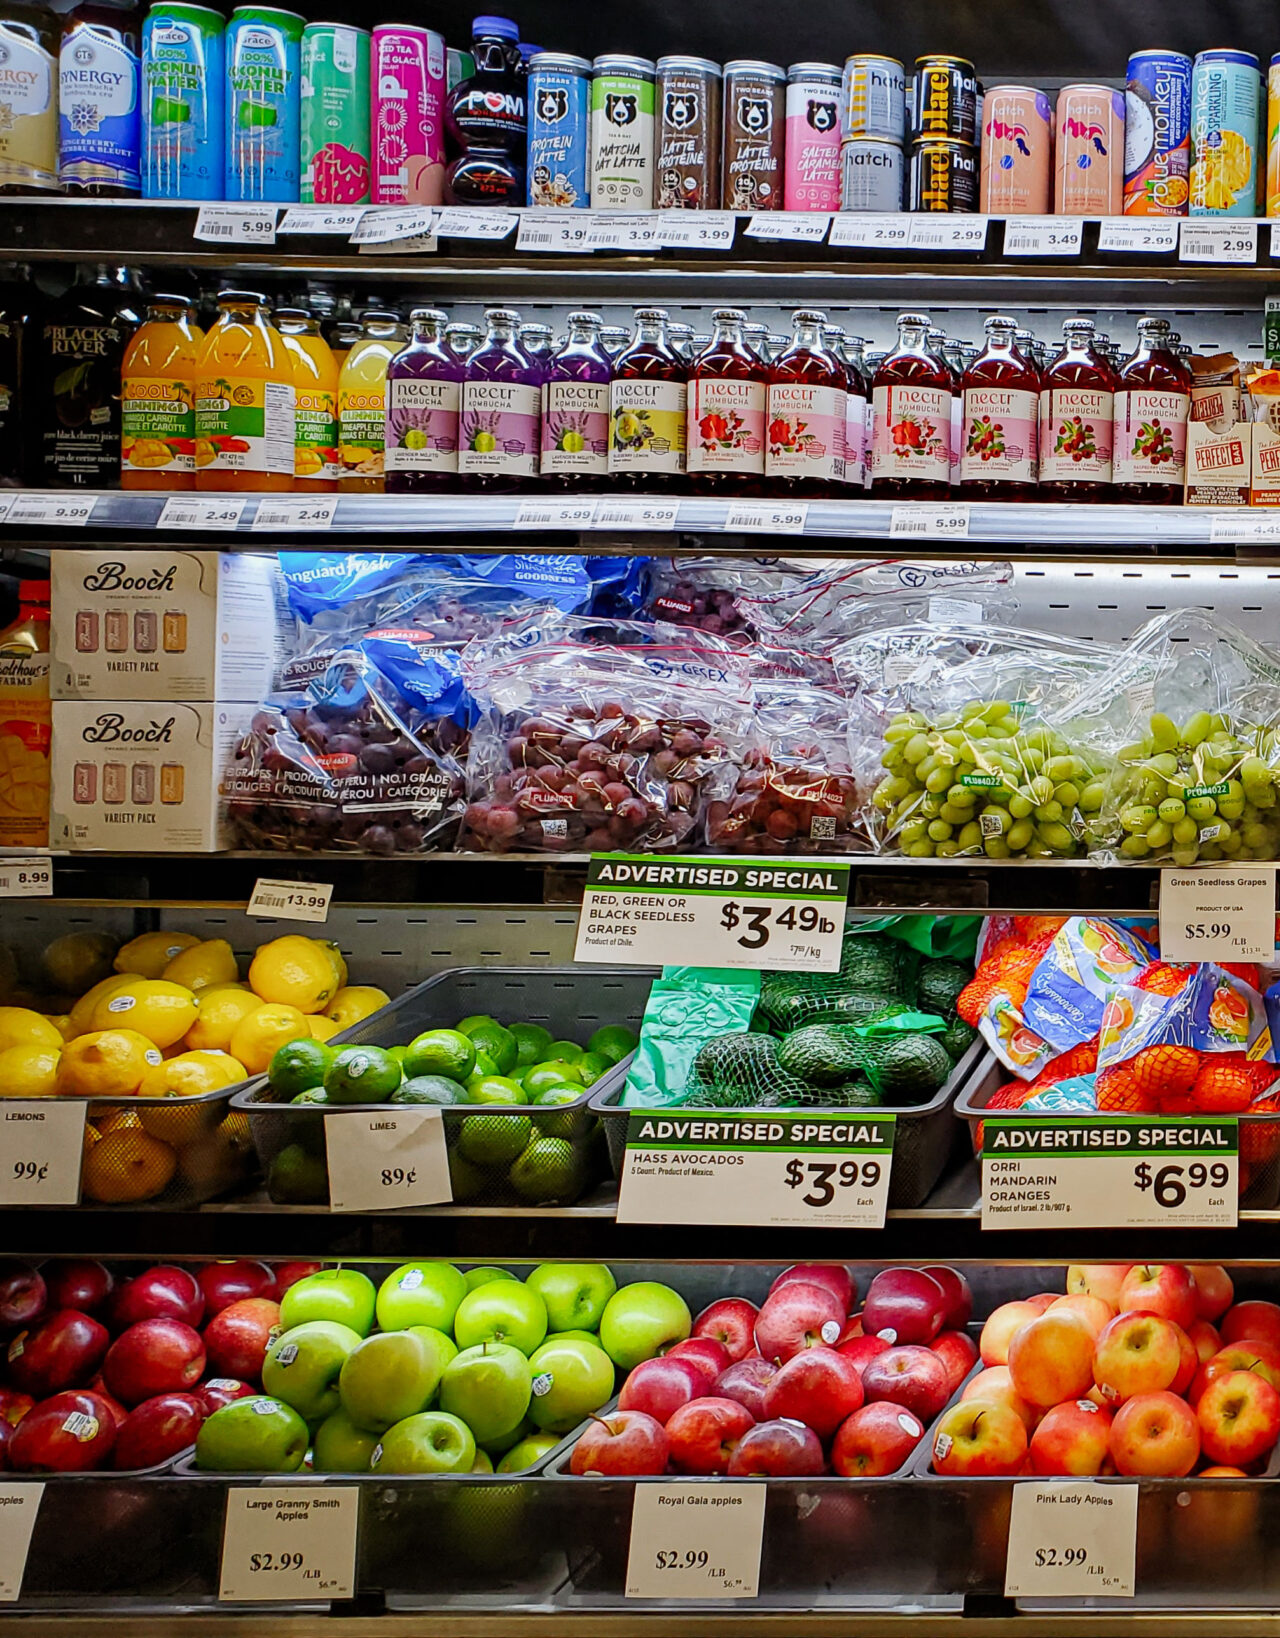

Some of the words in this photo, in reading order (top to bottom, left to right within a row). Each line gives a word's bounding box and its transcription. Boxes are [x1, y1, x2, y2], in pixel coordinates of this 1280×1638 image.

[232, 79, 286, 94] WATER
[600, 144, 641, 156] MATCHA
[802, 147, 838, 159] SALTED
[595, 159, 612, 172] OAT
[613, 156, 646, 169] LATTE
[797, 157, 843, 171] CARAMEL
[803, 169, 835, 181] LATTE
[242, 222, 272, 232] 5.99
[699, 230, 730, 240] 3.99
[875, 230, 906, 240] 2.99
[1048, 234, 1079, 245] 3.49
[1223, 240, 1253, 251] 2.99
[53, 327, 104, 341] BLACK
[53, 342, 105, 355] RIVER
[705, 383, 752, 397] nectr
[1196, 444, 1231, 471] PERFECT
[1232, 443, 1243, 465] BAR
[771, 515, 802, 524] 5.99
[83, 562, 177, 591] Booch
[107, 662, 135, 672] VARIETY
[138, 661, 160, 672] PACK
[19, 872, 49, 884] 8.99
[598, 865, 739, 886] ADVERTISED
[744, 870, 838, 890] SPECIAL
[1170, 879, 1196, 887] Green
[1198, 879, 1235, 887] Seedless
[1237, 879, 1267, 888] Grapes
[591, 895, 619, 907] RED,
[623, 896, 664, 907] GREEN
[668, 898, 686, 908] OR
[589, 909, 631, 920] BLACK
[634, 911, 695, 922] SEEDLESS
[587, 925, 637, 935] GRAPES
[1185, 924, 1231, 940] $5.99
[584, 937, 609, 946] Product
[1231, 938, 1247, 946] /LB
[5, 1113, 45, 1121] LEMONS
[369, 1121, 397, 1130] LIMES
[638, 1121, 784, 1141] ADVERTISED
[790, 1124, 884, 1143] SPECIAL
[993, 1129, 1131, 1148] ADVERTISED
[1138, 1128, 1228, 1145] SPECIAL
[633, 1153, 668, 1163] HASS
[671, 1154, 744, 1165] AVOCADOS
[13, 1161, 49, 1182] 99¢
[637, 1167, 656, 1175] Count.
[692, 1168, 715, 1176] Mexico.
[990, 1163, 1020, 1172] ORRI
[381, 1167, 417, 1187] 89¢
[990, 1176, 1057, 1186] MANDARIN
[857, 1198, 873, 1206] Each
[990, 1191, 1050, 1201] ORANGES
[1208, 1198, 1224, 1206] Each
[989, 1204, 1012, 1213] Product
[1021, 1204, 1039, 1212] Israel.
[246, 1499, 273, 1509] Large
[275, 1500, 310, 1510] Granny
[313, 1499, 340, 1508] Smith
[658, 1495, 685, 1506] Royal
[687, 1495, 708, 1505] Gala
[711, 1495, 742, 1507] apples
[1036, 1494, 1057, 1503] Pink
[1059, 1494, 1082, 1505] Lady
[1084, 1494, 1113, 1506] Apples
[275, 1511, 308, 1520] Apples
[250, 1553, 304, 1572] $2.99
[655, 1550, 709, 1569] $2.99
[1035, 1548, 1087, 1567] $2.99
[303, 1570, 321, 1579] /LB
[708, 1568, 726, 1577] /LB
[1087, 1565, 1104, 1574] /LB
